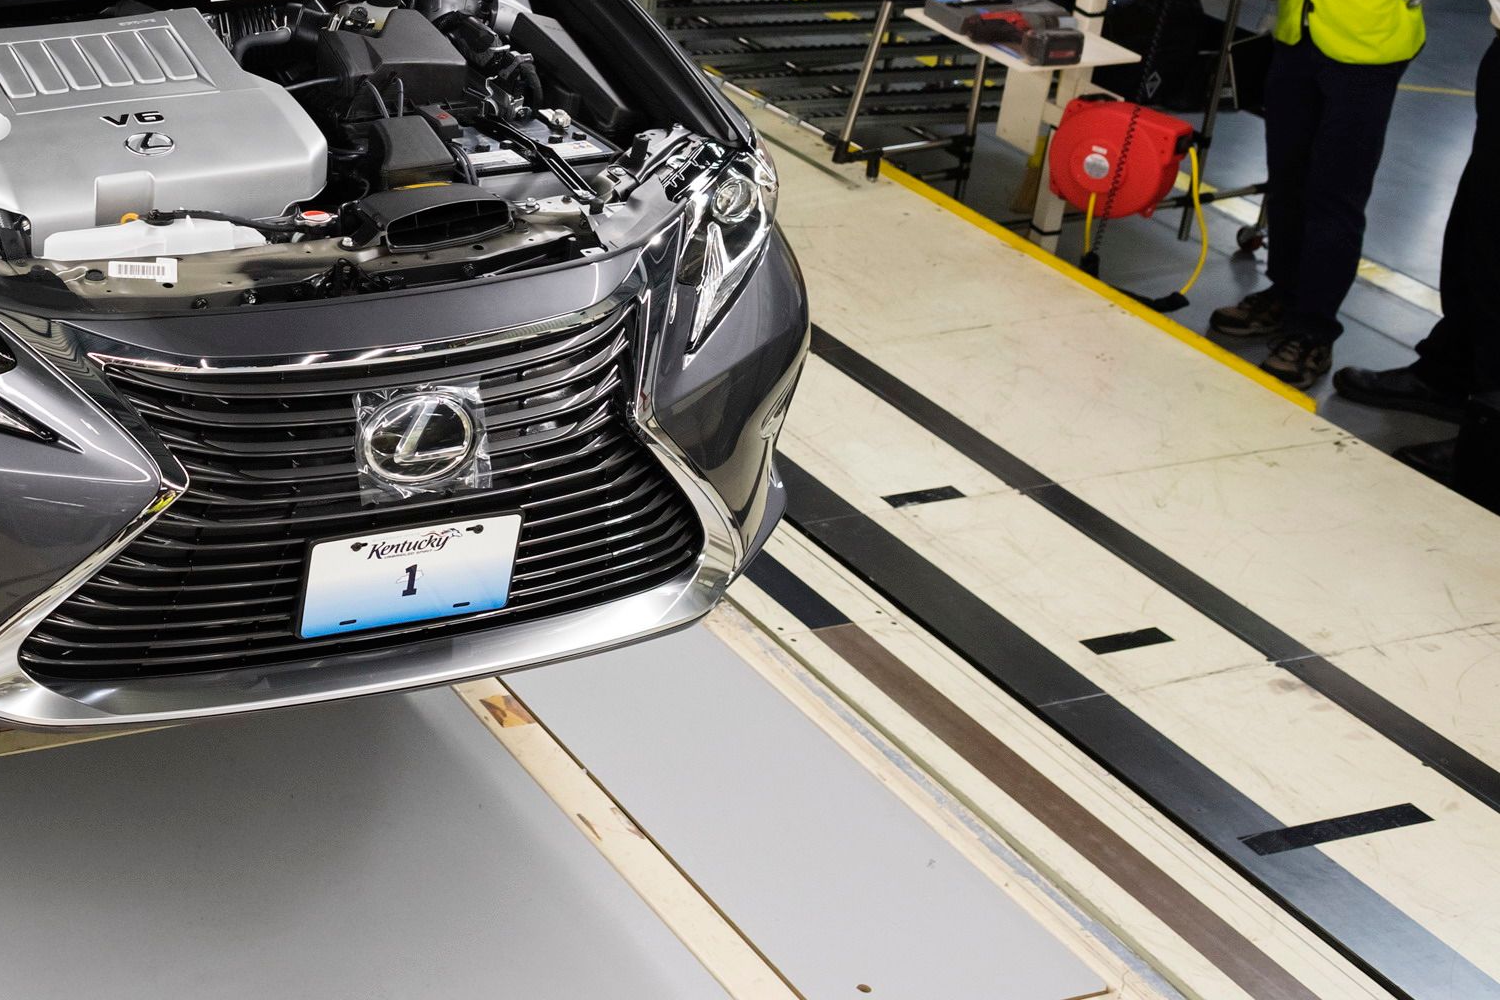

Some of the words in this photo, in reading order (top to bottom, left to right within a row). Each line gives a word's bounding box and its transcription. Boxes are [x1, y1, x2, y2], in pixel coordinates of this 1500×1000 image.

[100, 110, 165, 128] V6
[367, 535, 450, 560] Kentucky
[402, 564, 418, 596] 1
